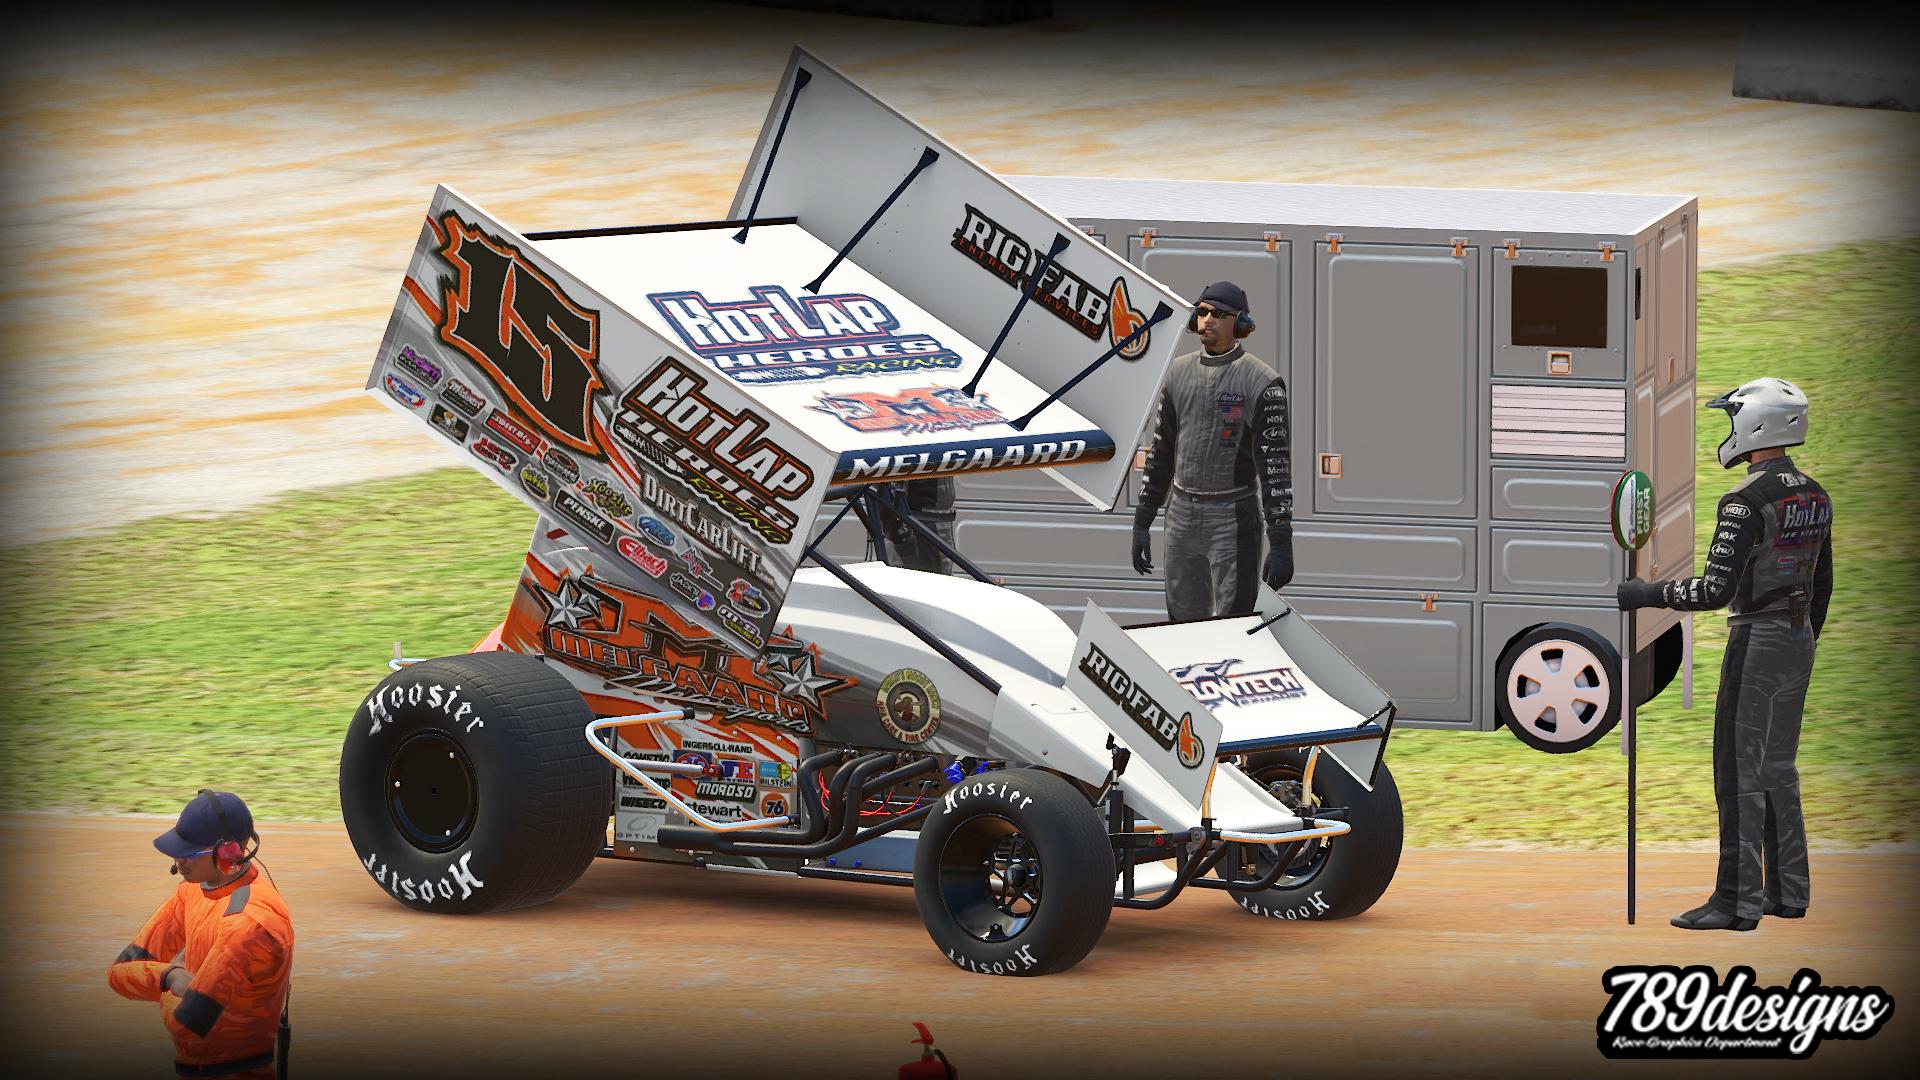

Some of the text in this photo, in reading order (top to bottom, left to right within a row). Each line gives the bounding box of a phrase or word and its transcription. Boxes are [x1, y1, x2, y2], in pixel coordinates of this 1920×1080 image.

[964, 210, 1109, 327] RIG FAB
[443, 214, 599, 456] 15
[714, 338, 943, 369] HEROES
[620, 409, 795, 530] HEROES
[846, 438, 1088, 481] MELGAARD
[563, 496, 607, 531] PENSKE
[1636, 488, 1644, 535] FIRST
[1643, 487, 1651, 534] GEAR
[1717, 531, 1738, 542] NGK
[551, 628, 809, 722] MELGAARD
[1086, 648, 1129, 696] RIG
[1130, 688, 1179, 742] FAB
[1180, 668, 1302, 706] LOWTECH
[365, 681, 487, 737] Hoosier
[682, 739, 754, 754] INGERSOLL-RAND
[696, 782, 756, 799] MOROSO
[760, 777, 792, 788] BILSTEIN
[942, 781, 1034, 815] Hoosier
[766, 800, 785, 816] 76
[363, 850, 485, 905] Hoosier
[946, 943, 1038, 976] Hoosier
